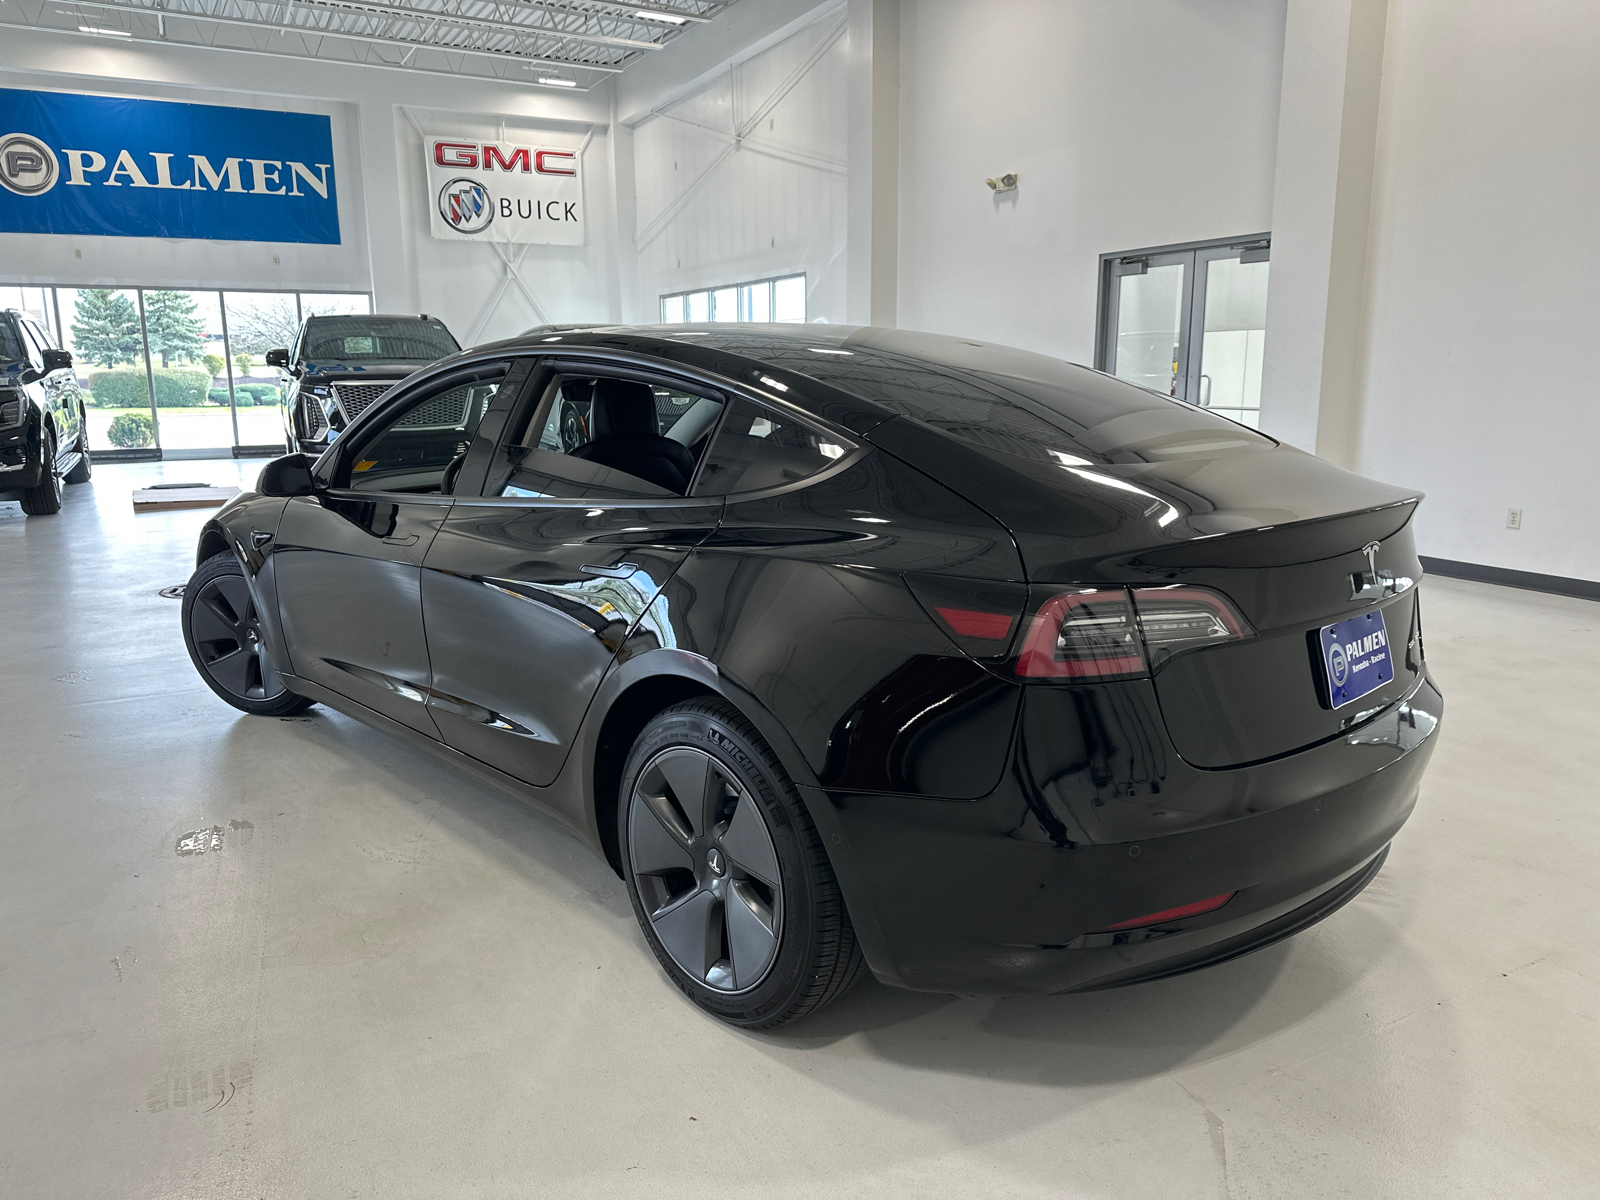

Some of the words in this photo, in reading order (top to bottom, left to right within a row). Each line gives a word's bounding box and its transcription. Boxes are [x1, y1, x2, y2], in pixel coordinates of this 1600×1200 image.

[61, 149, 331, 199] PALMEN
[433, 140, 577, 177] GMC
[500, 197, 578, 222] BUICK
[1345, 629, 1386, 662] PALMEN
[1352, 659, 1370, 673] Kenosha
[1371, 652, 1386, 664] Racine
[721, 738, 777, 803] MICHELIN
